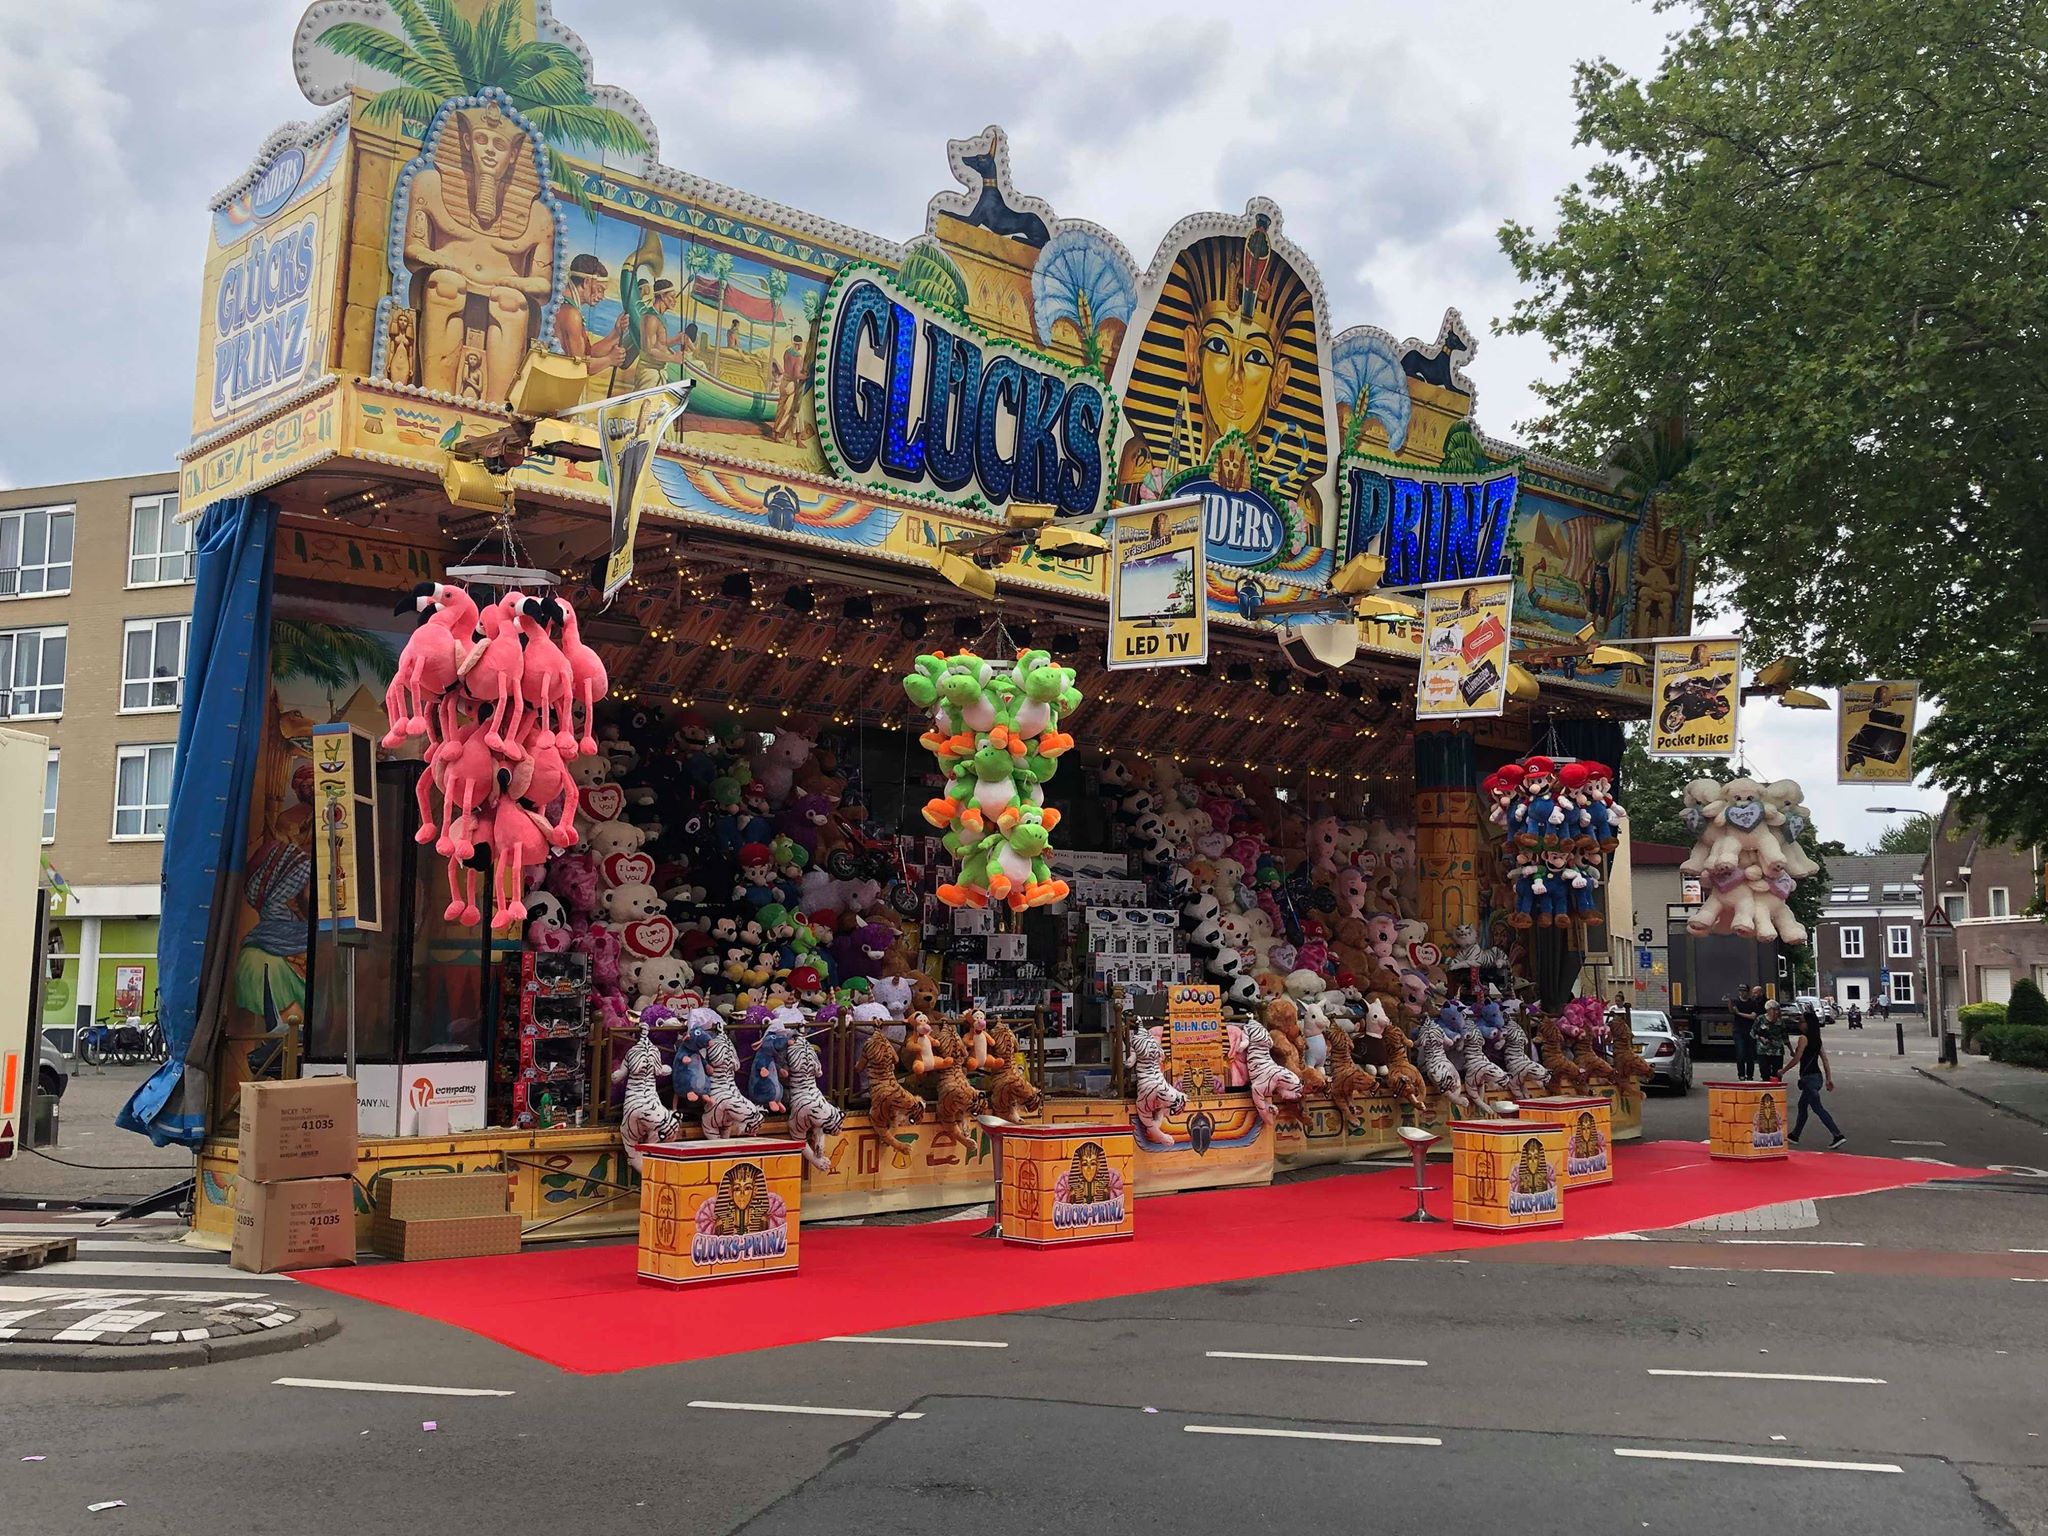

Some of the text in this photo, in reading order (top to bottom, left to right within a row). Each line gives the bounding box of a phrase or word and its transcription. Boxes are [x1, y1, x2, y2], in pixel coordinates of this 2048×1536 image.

[256, 158, 300, 206] ENDERS
[217, 222, 314, 337] GLÜCKS
[214, 299, 309, 407] PRINZ
[1345, 466, 1517, 588] PRINZ
[1126, 632, 1190, 656] LED TV
[1657, 733, 1729, 749] Pocket bikes
[1887, 768, 1907, 778] ONE
[435, 1085, 476, 1095] company
[301, 1120, 334, 1130] 41035
[310, 1215, 340, 1226] 41035
